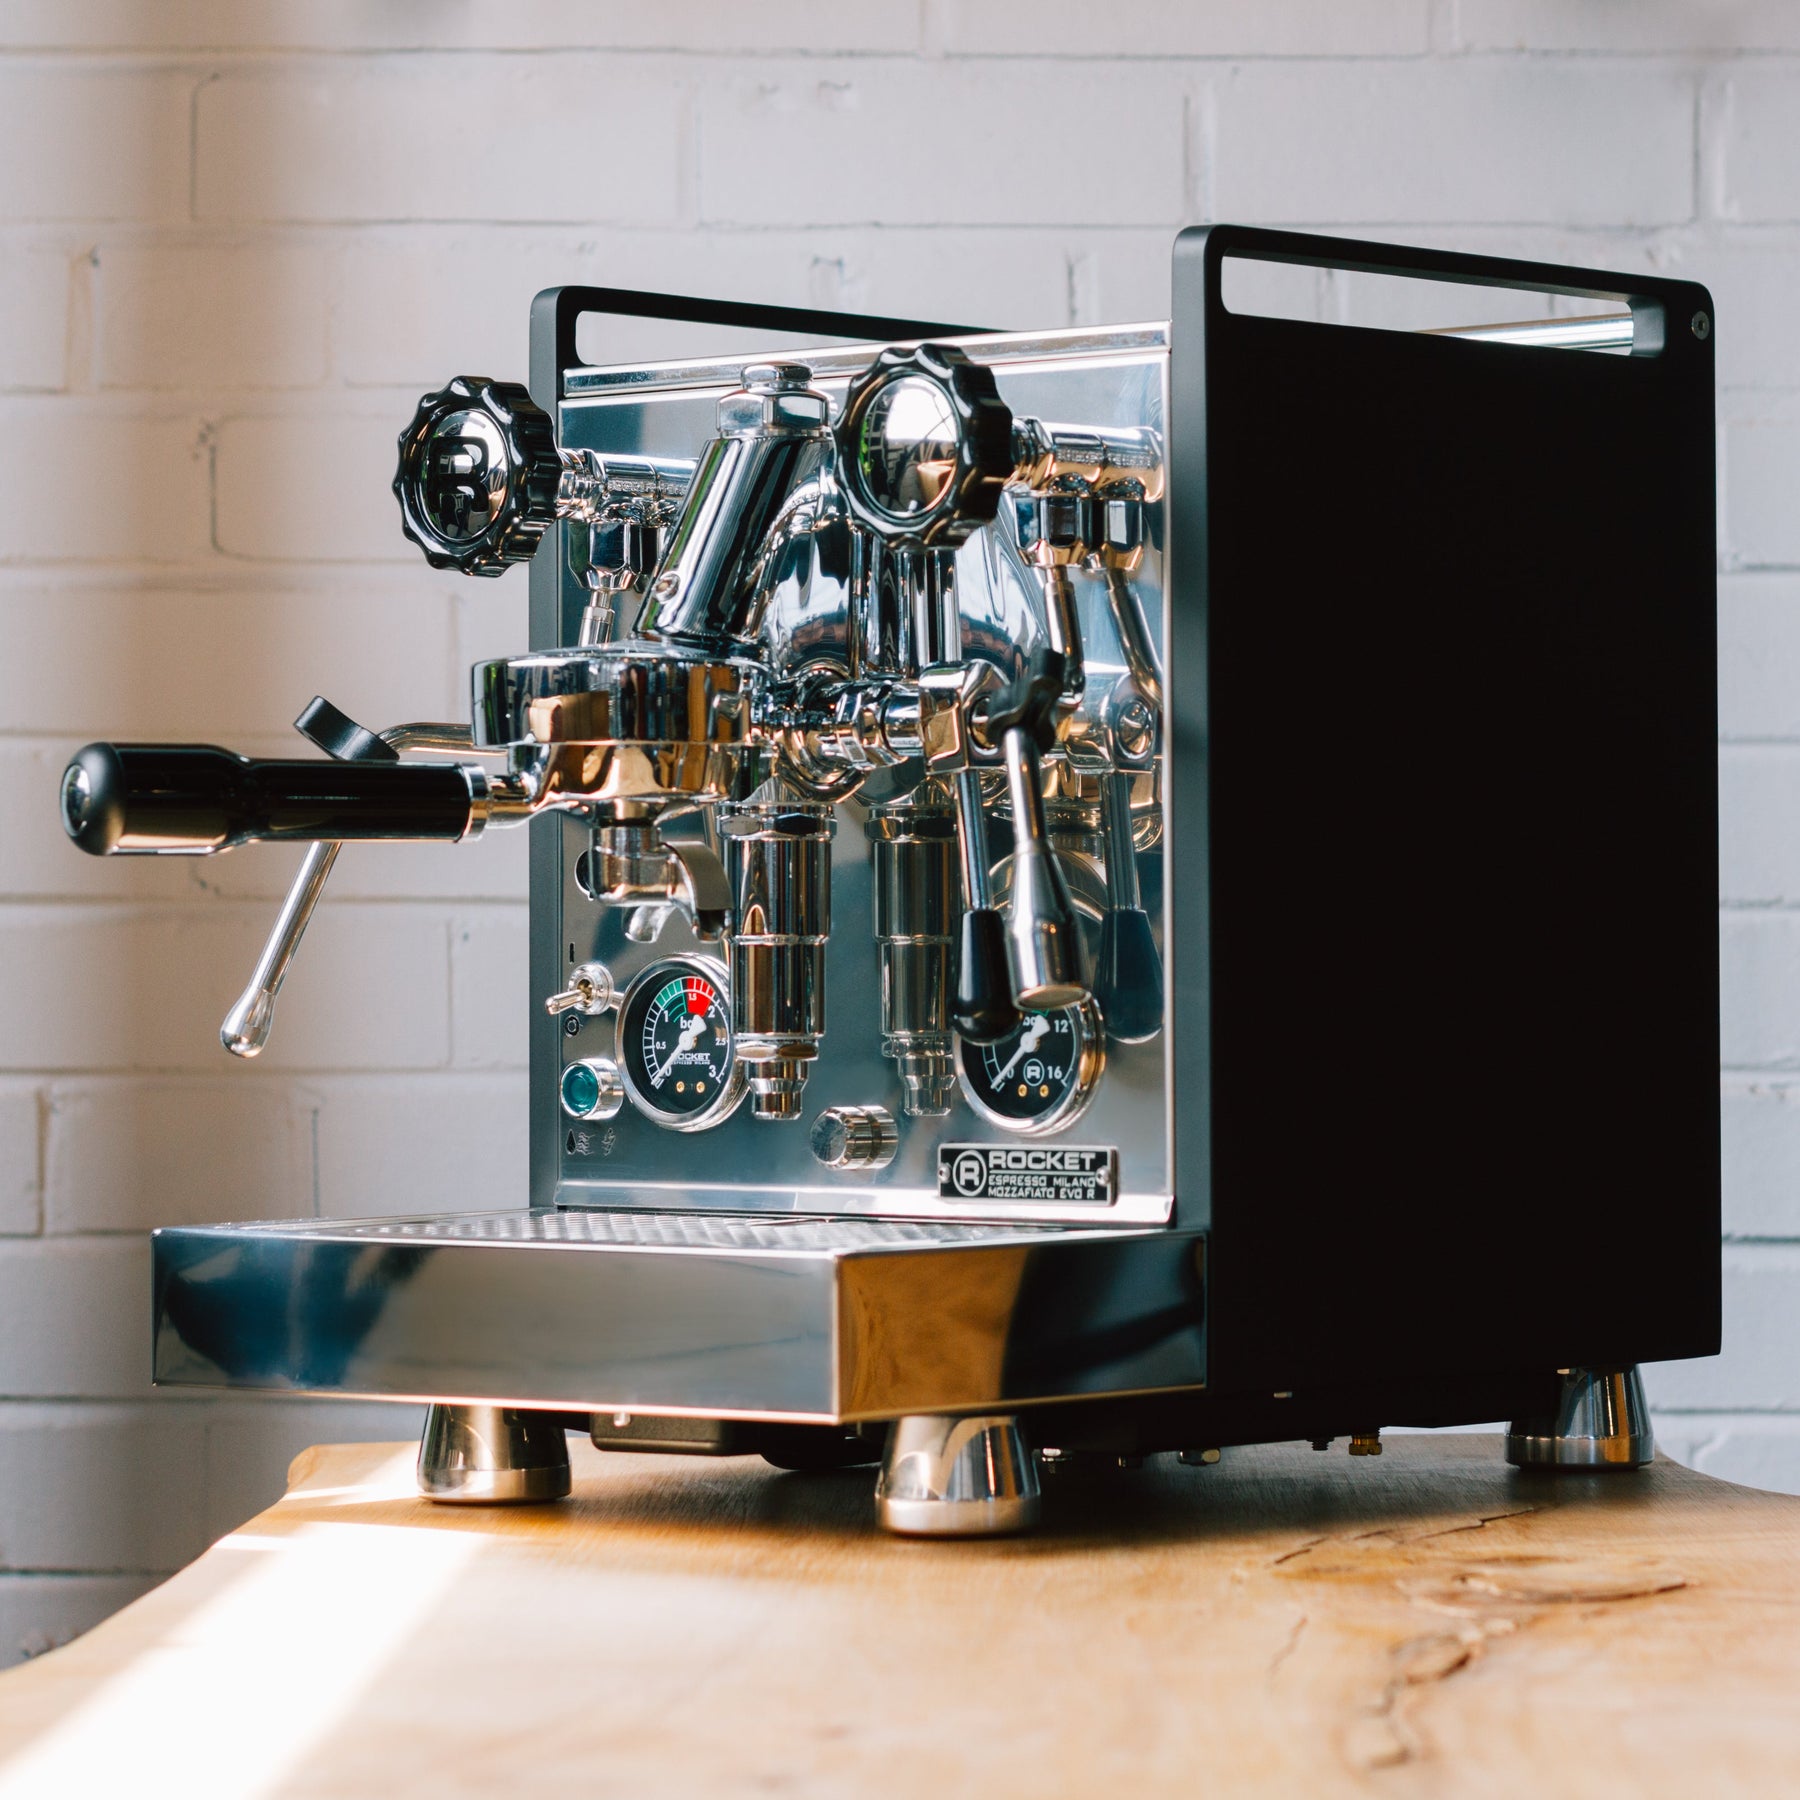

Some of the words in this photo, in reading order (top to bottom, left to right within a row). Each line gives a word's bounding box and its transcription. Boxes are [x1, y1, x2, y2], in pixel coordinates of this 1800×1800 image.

[688, 993, 697, 1001] 1.5
[663, 1010, 669, 1023] 1
[708, 1005, 715, 1017] 2
[680, 1016, 694, 1028] ba
[1054, 1020, 1068, 1032] 12
[656, 1041, 666, 1049] 0.5
[709, 1065, 716, 1077] 3
[1027, 1066, 1040, 1079] R
[1047, 1066, 1062, 1079] 16
[988, 1151, 1095, 1170] ROCKET
[959, 1159, 980, 1187] R
[988, 1175, 1047, 1187] ESPRESSO
[1053, 1176, 1096, 1188] MILANO
[988, 1187, 1055, 1198] MOZZAFIATO
[1059, 1187, 1083, 1199] EVO
[1086, 1188, 1095, 1199] R
